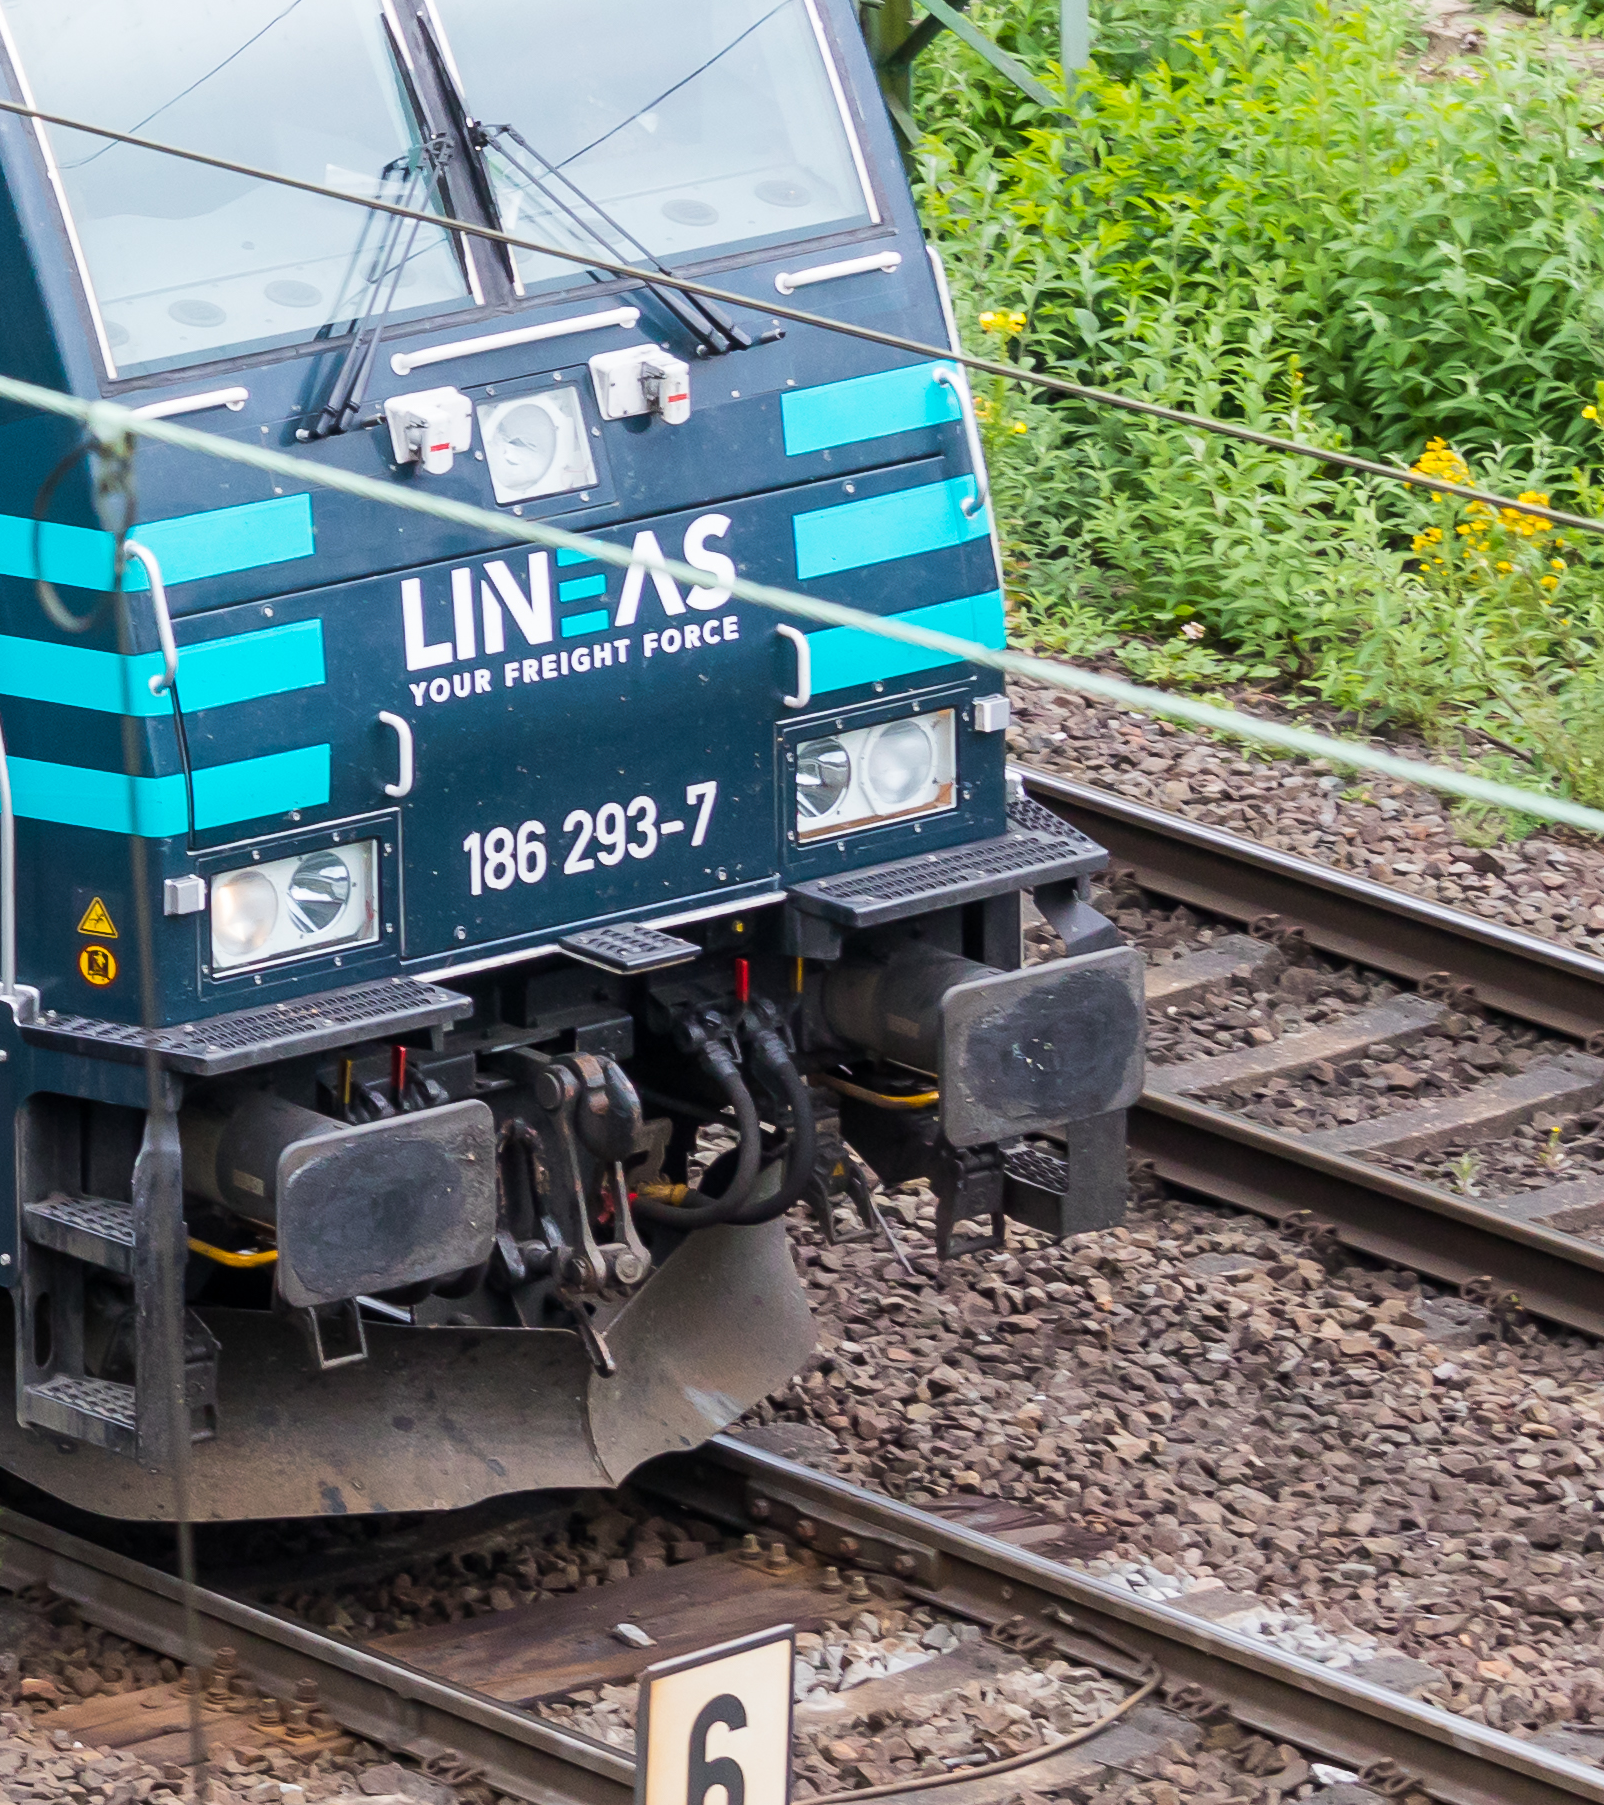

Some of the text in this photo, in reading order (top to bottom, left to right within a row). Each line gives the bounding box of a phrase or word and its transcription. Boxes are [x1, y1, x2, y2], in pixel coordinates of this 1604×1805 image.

[401, 513, 737, 671] LINEAS
[409, 615, 740, 707] YOUR FREIGHT FORCE
[462, 780, 718, 896] 186 293-7
[686, 1693, 749, 1805] 6
